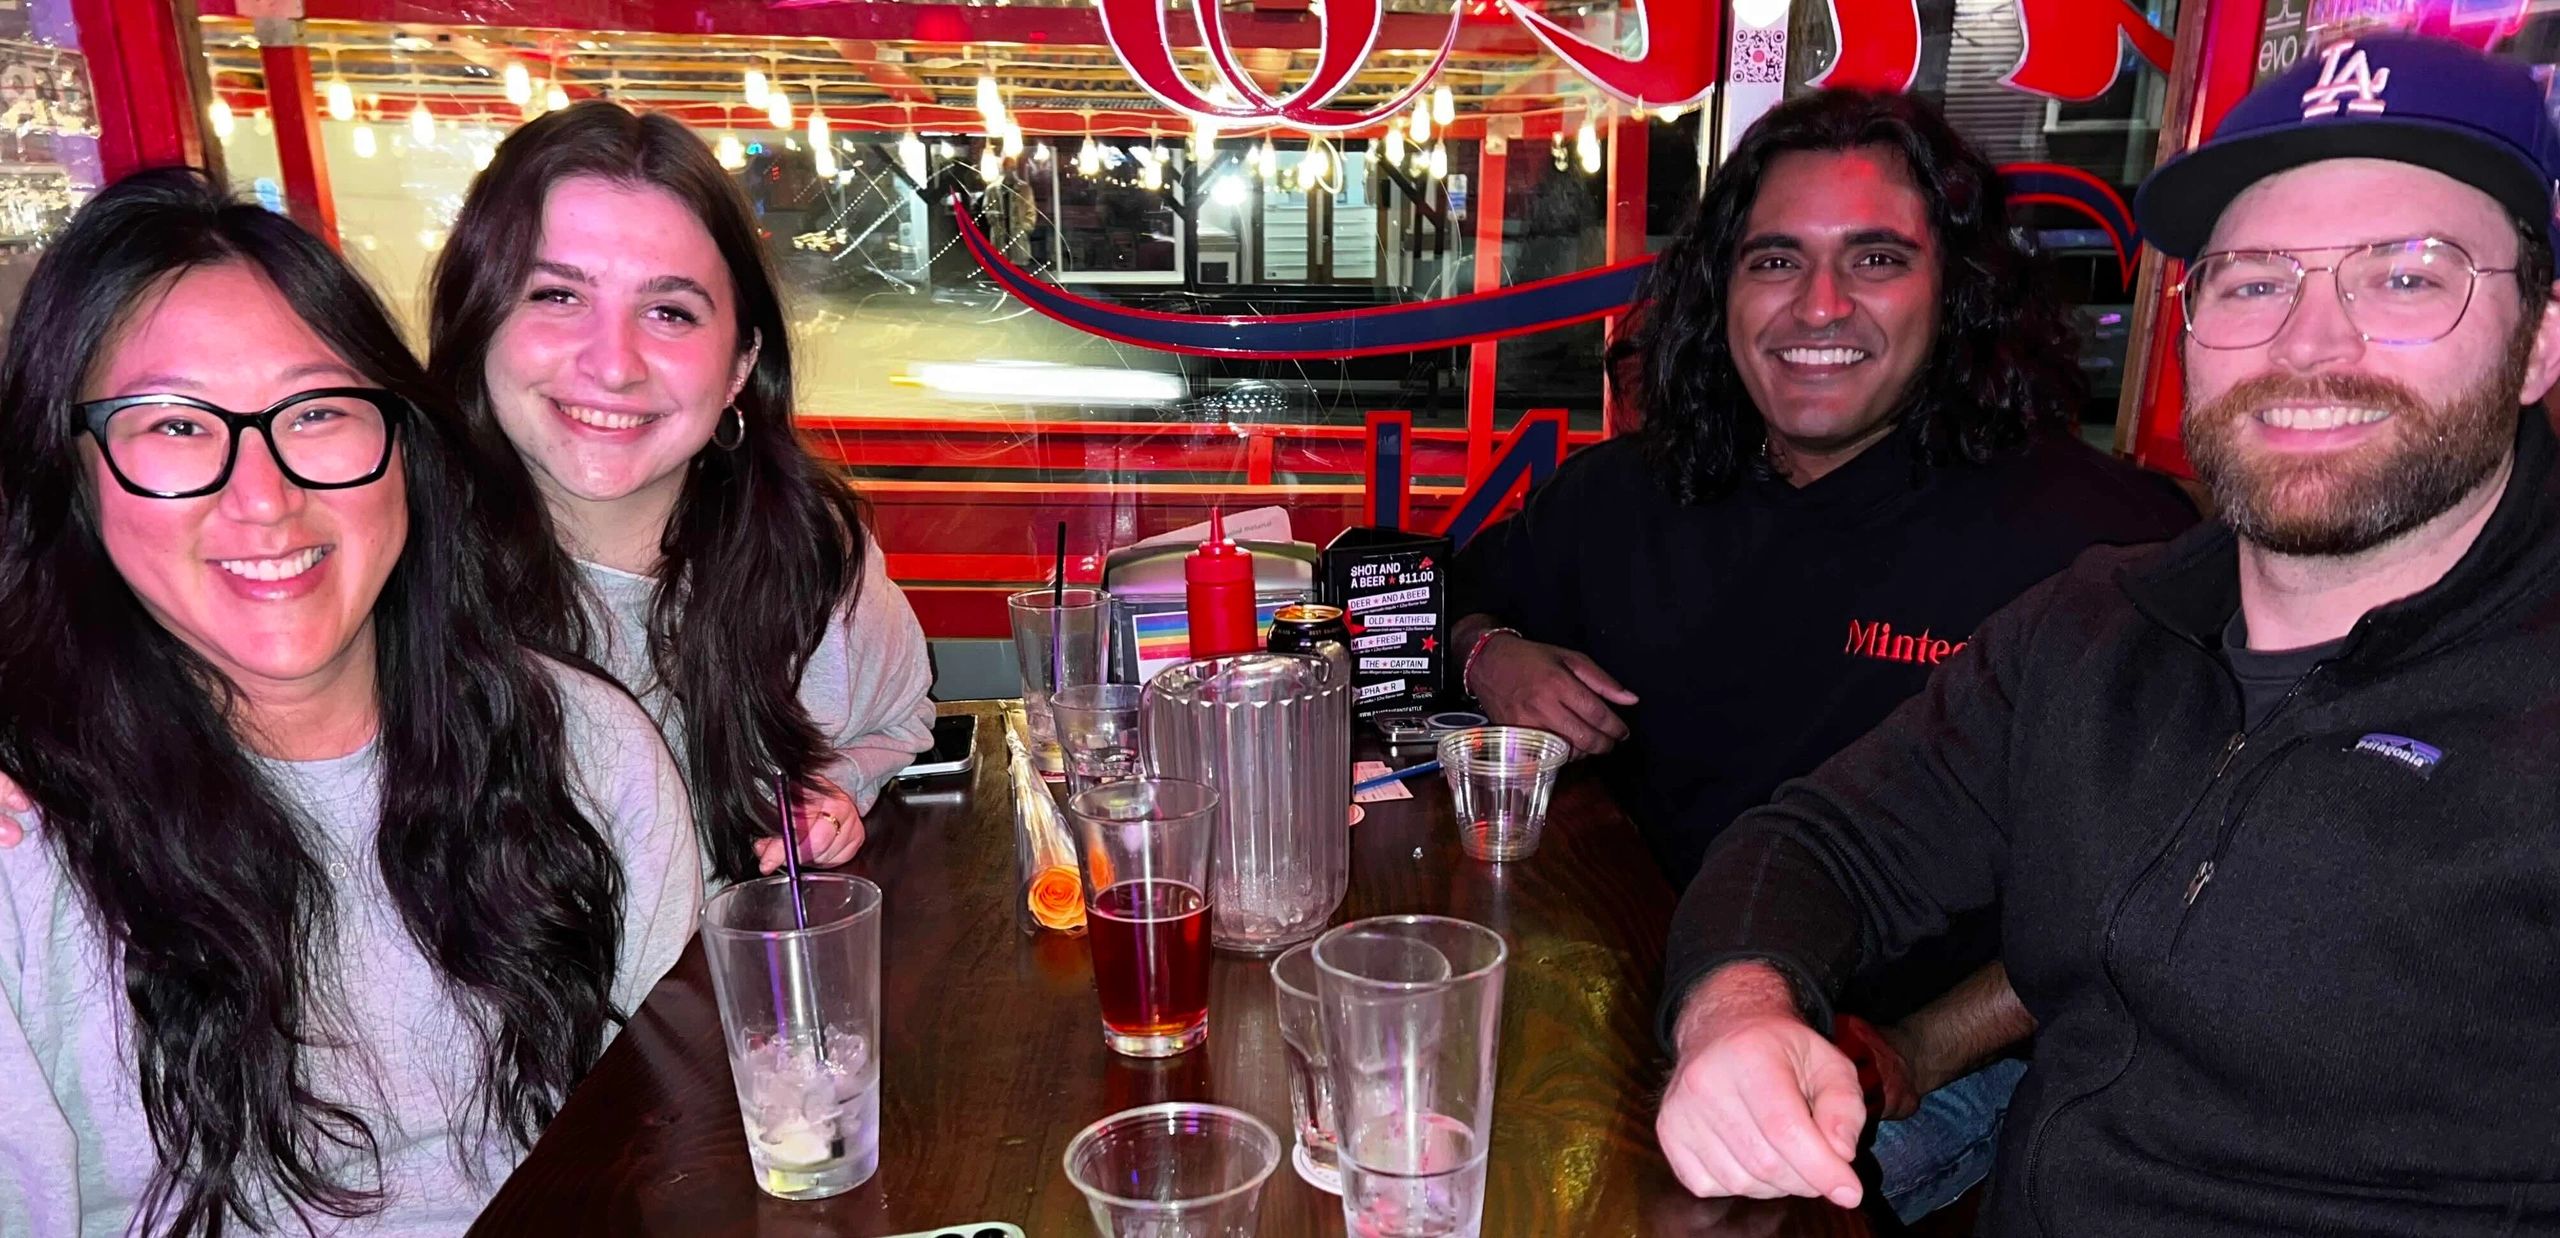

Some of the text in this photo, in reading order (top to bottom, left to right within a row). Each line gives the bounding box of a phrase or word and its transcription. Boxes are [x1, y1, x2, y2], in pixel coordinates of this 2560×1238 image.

[2302, 39, 2391, 118] LA
[1350, 562, 1401, 577] SHOT AND
[1350, 571, 1434, 589] A BEER $11.00
[1350, 598, 1371, 609] DEER
[1381, 593, 1399, 603] AND
[1399, 592, 1405, 600] A
[1406, 588, 1427, 598] BEER
[1368, 615, 1431, 625] OLD FAITHFUL
[1376, 634, 1402, 643] FRESH
[1365, 660, 1423, 668] THE CAPTAIN
[2354, 739, 2425, 768] patagonia
